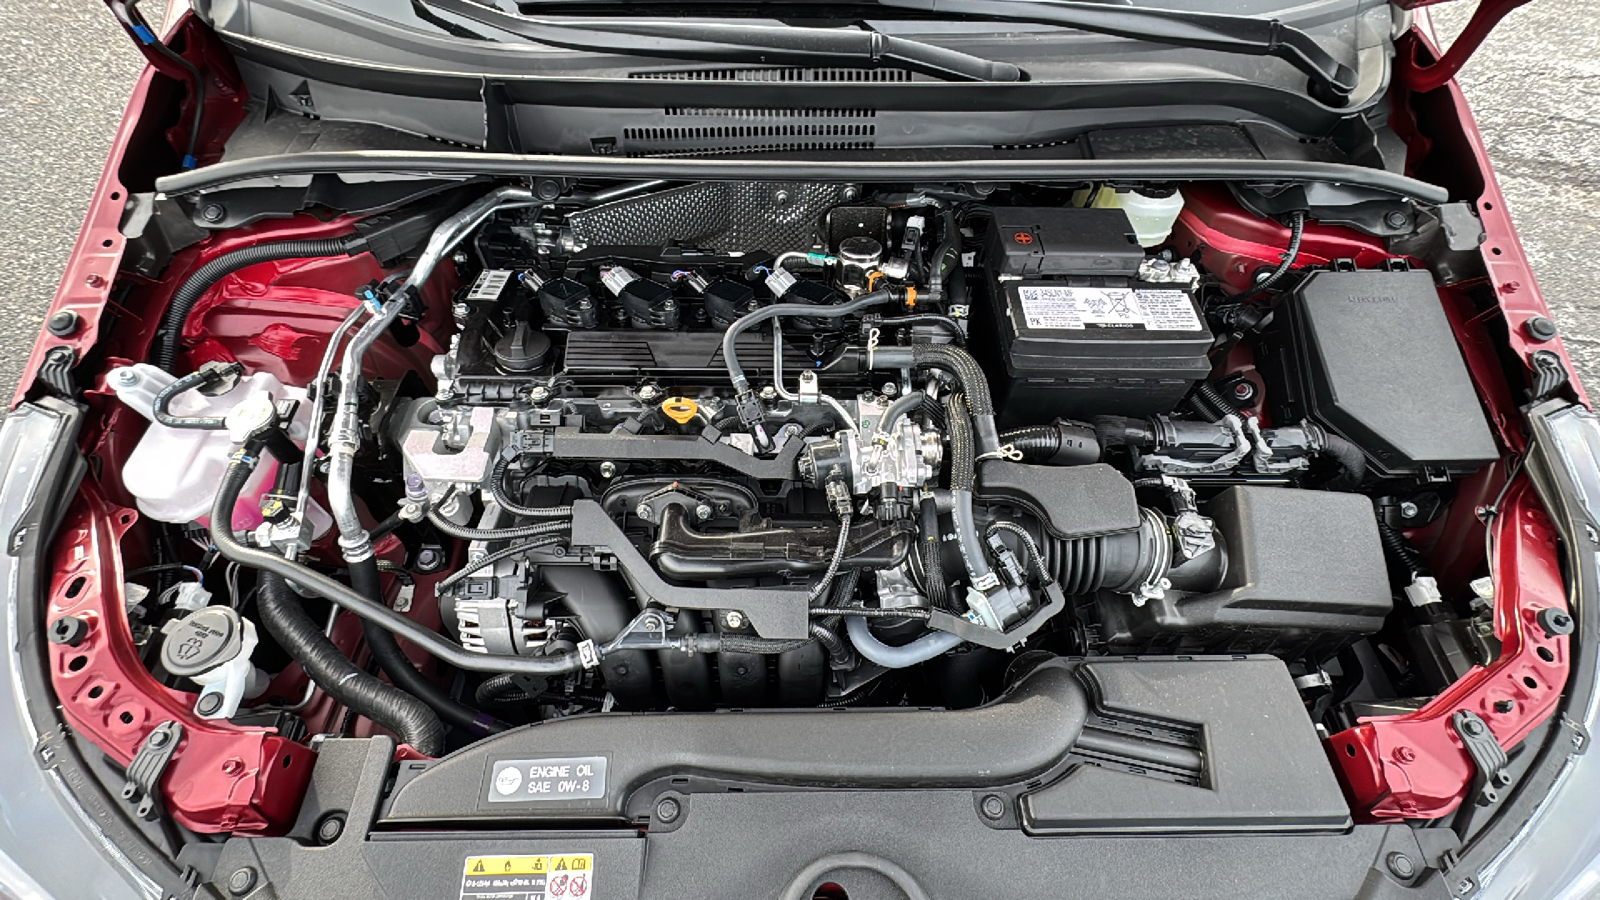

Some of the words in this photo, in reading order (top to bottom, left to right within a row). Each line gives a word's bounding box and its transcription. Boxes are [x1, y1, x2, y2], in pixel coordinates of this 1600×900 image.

[529, 766, 570, 778] ENGINE
[576, 765, 594, 777] OIL
[527, 781, 551, 794] SAE
[558, 780, 590, 792] 0W-8
